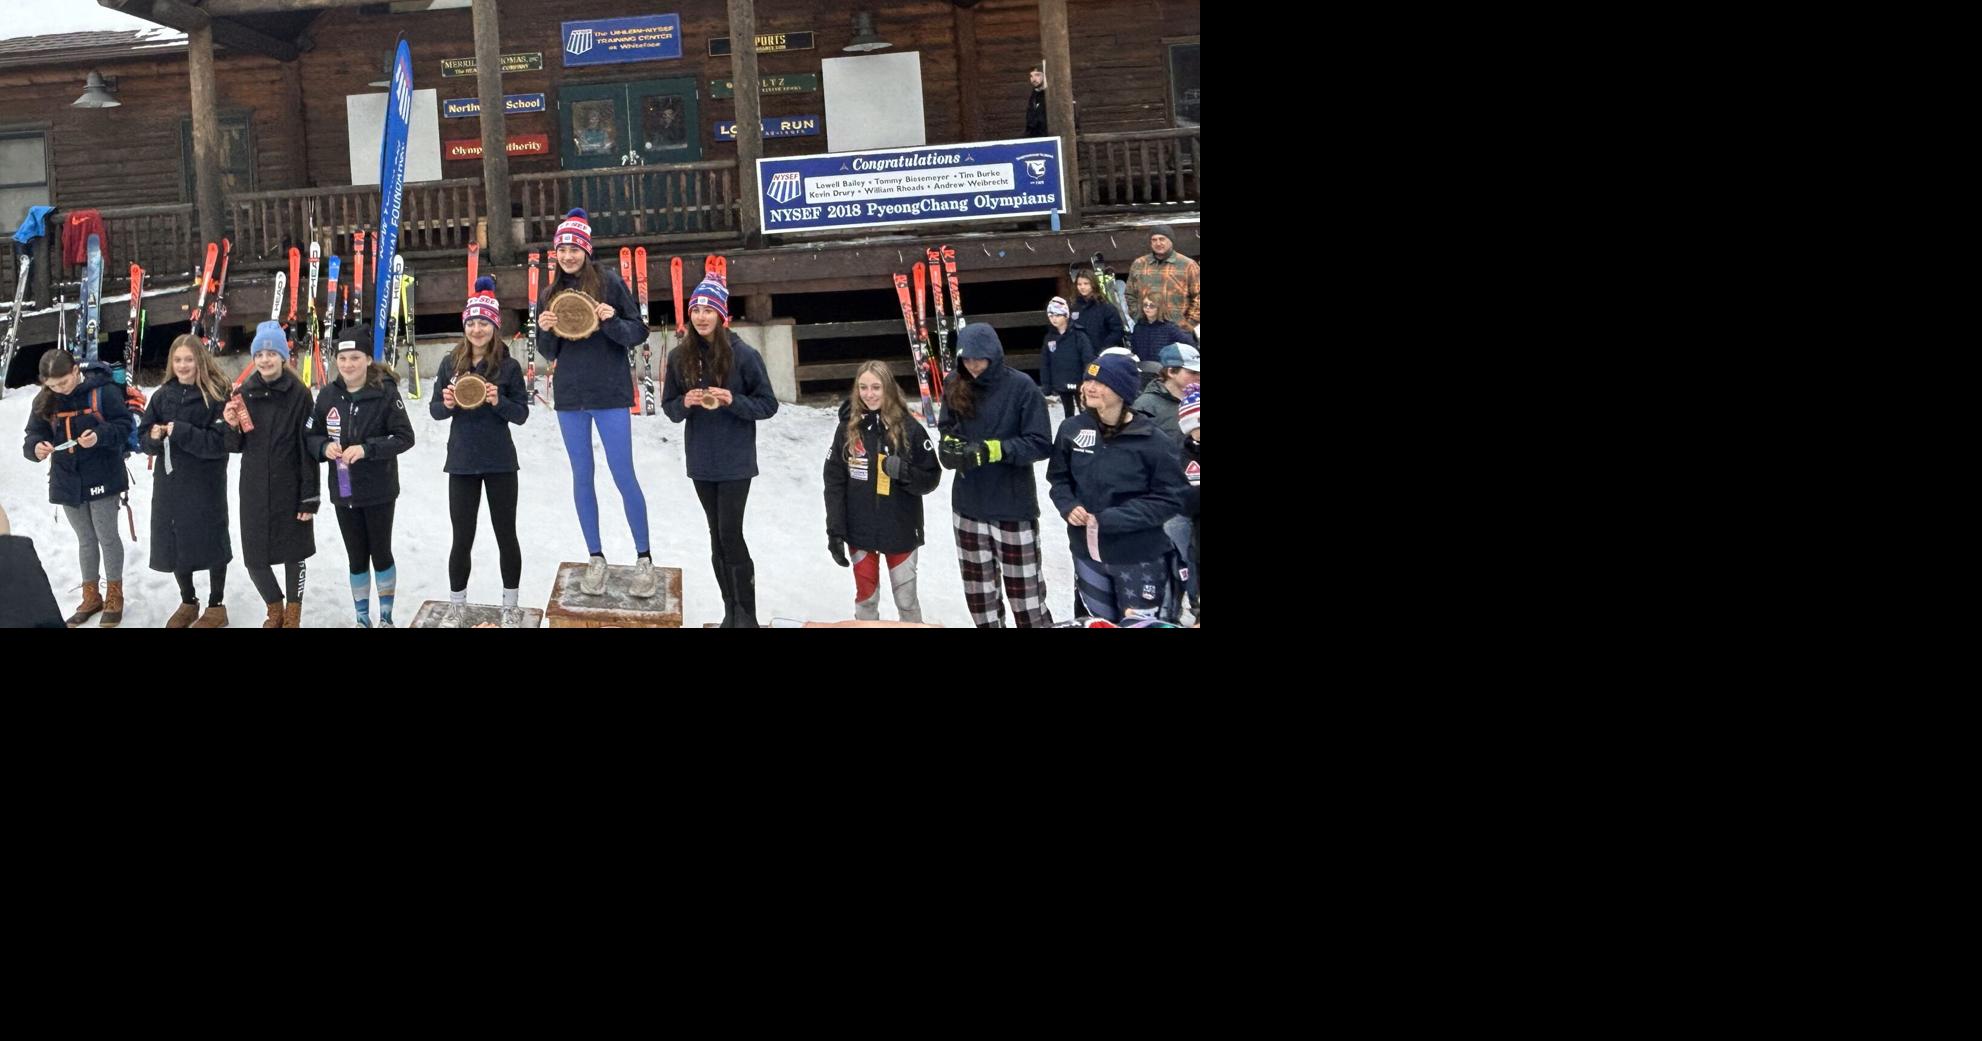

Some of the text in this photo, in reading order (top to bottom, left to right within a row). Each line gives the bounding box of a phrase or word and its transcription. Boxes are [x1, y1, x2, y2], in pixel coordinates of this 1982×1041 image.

[596, 33, 673, 44] TRAINING CENTER
[754, 35, 786, 46] PORTS
[619, 42, 661, 50] Whiteface
[505, 98, 540, 109] School
[780, 119, 814, 131] RUN
[452, 146, 483, 156] Olymp
[852, 152, 960, 171] Congratulations
[773, 173, 799, 181] NYSEF
[815, 169, 1001, 189] Lowell Bailey Tommy Biesemeyer Tim Burke
[809, 178, 1009, 198] Kevin Drury William Rhoads Andrew Weibrecht
[770, 191, 1056, 223] NYSEF 2018 PyeongChang Olympians
[274, 280, 284, 311] HEAD
[90, 485, 105, 496] HH
